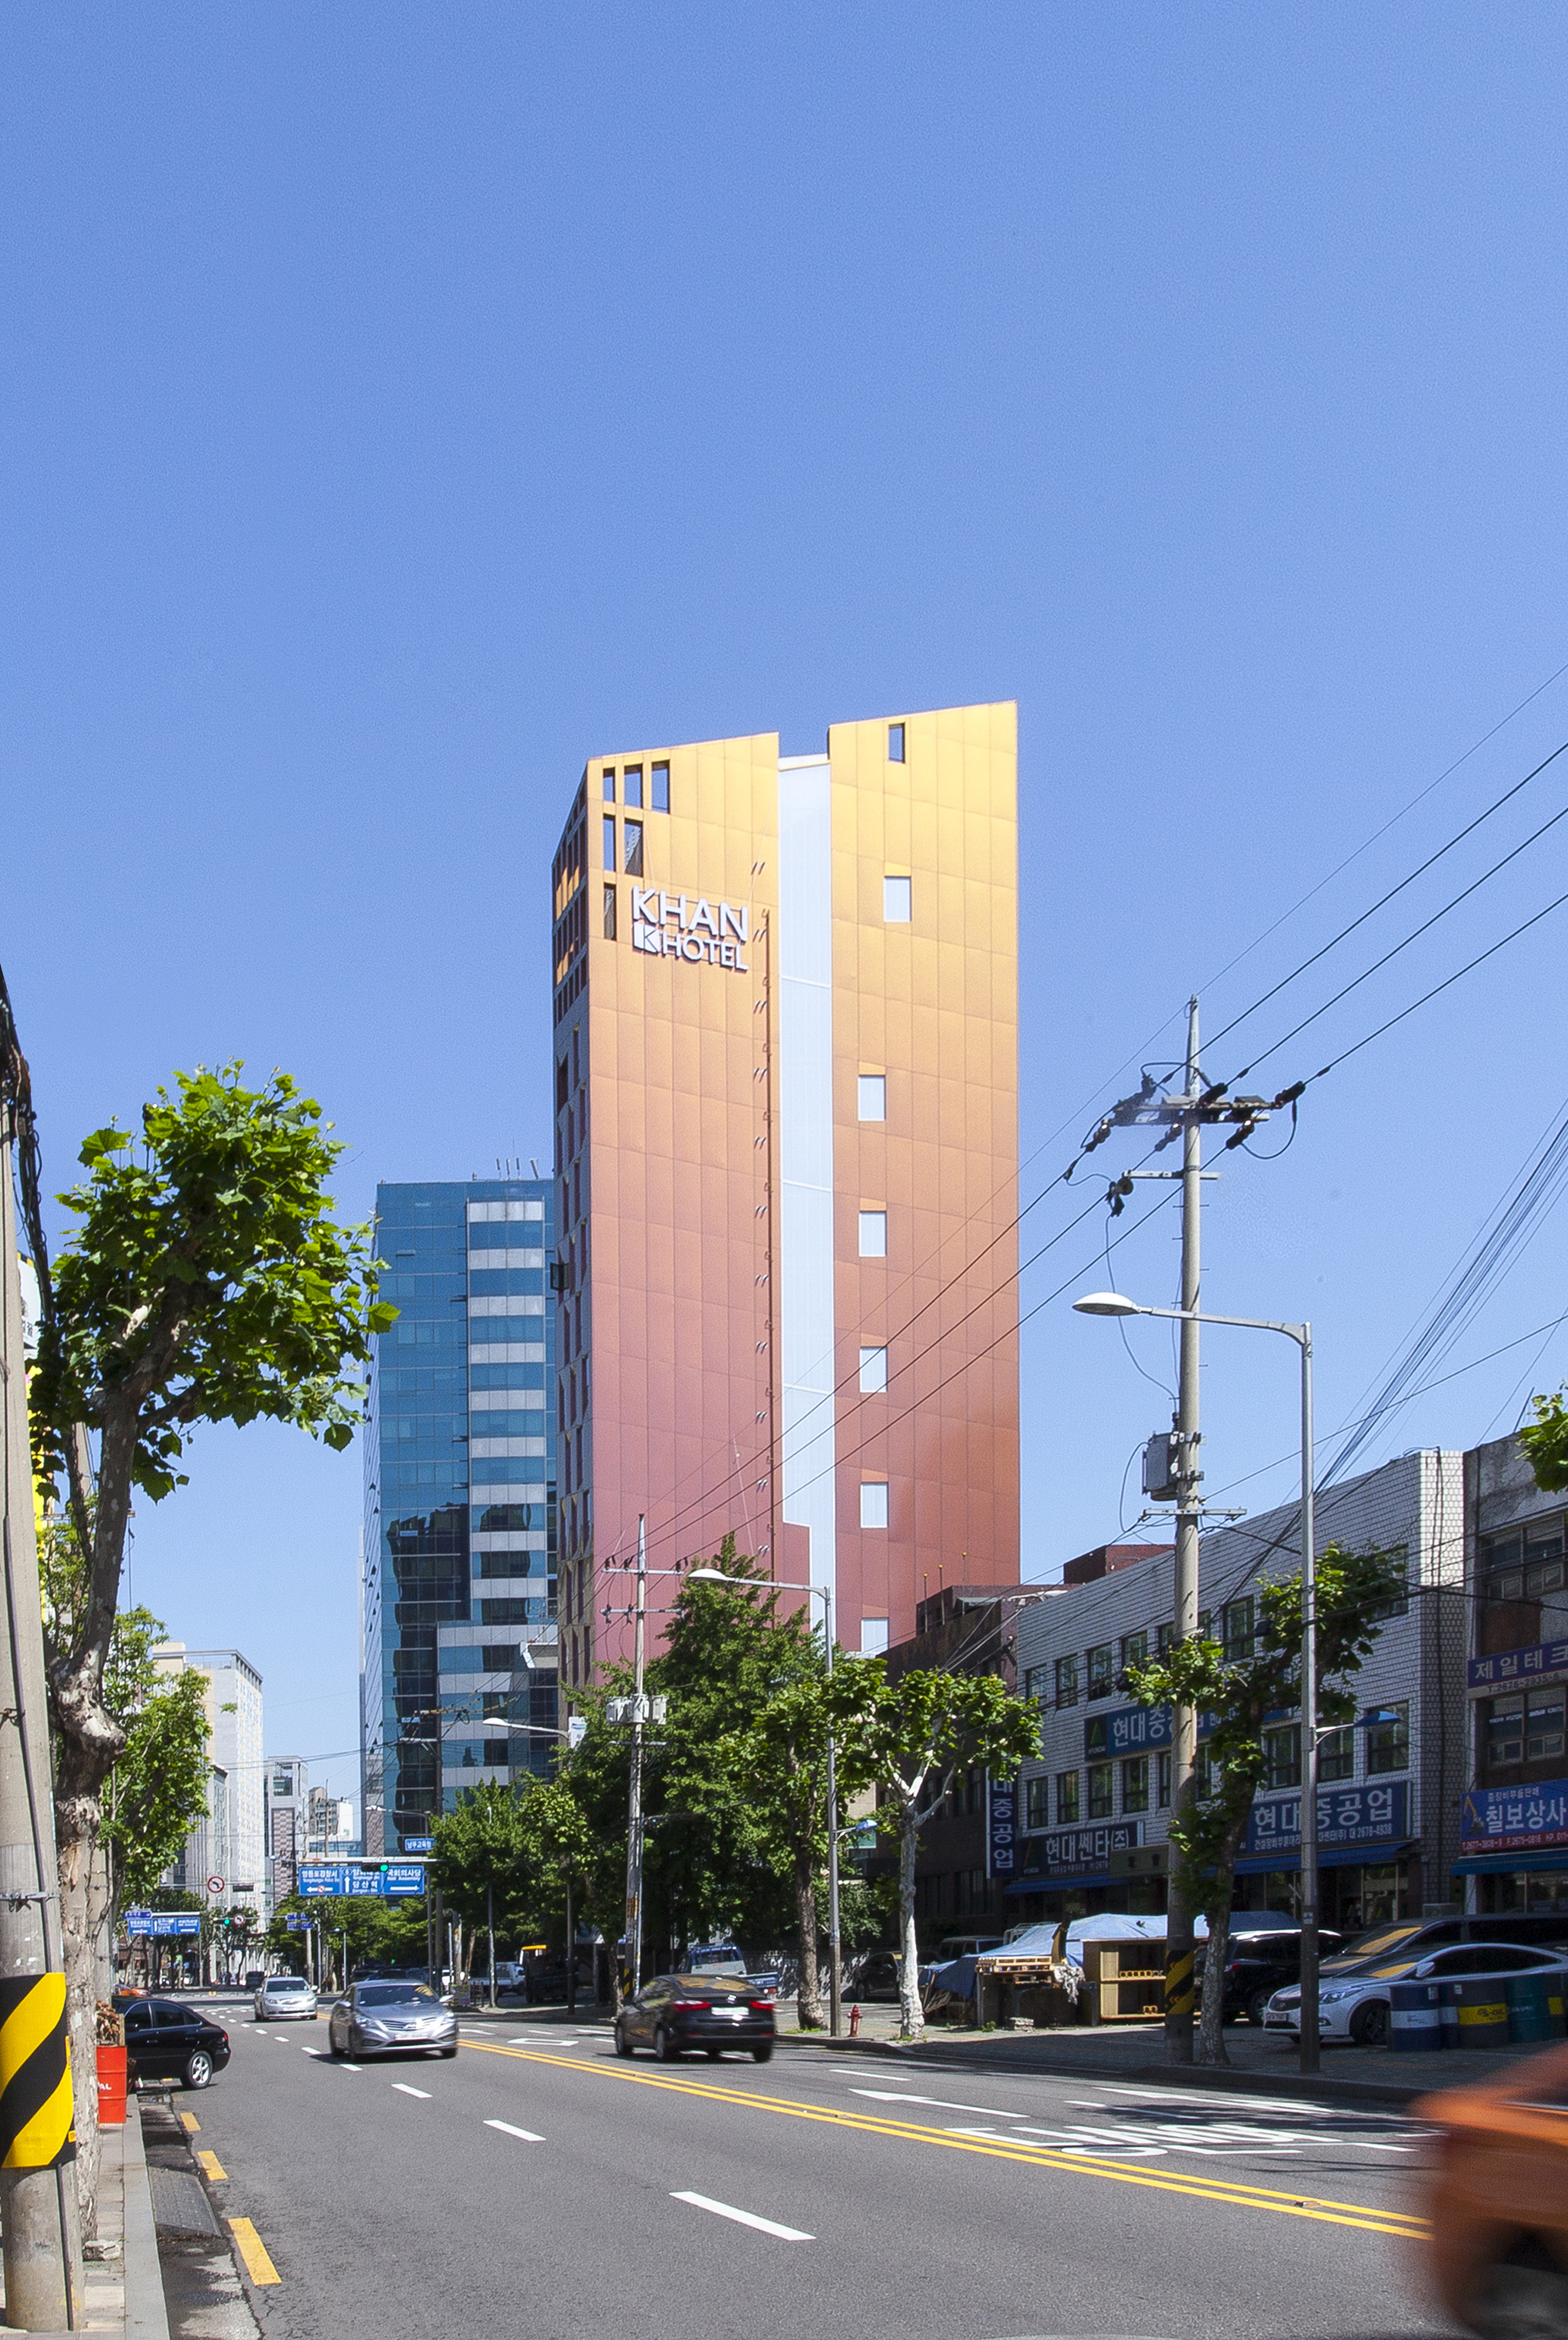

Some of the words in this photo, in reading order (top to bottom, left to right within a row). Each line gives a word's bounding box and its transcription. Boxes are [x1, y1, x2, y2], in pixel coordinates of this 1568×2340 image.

[632, 885, 748, 942] KHAN
[662, 930, 750, 970] HOTEL
[1486, 1797, 1566, 1833] 칠보상사
[302, 1869, 338, 1878] 영등포경찰서
